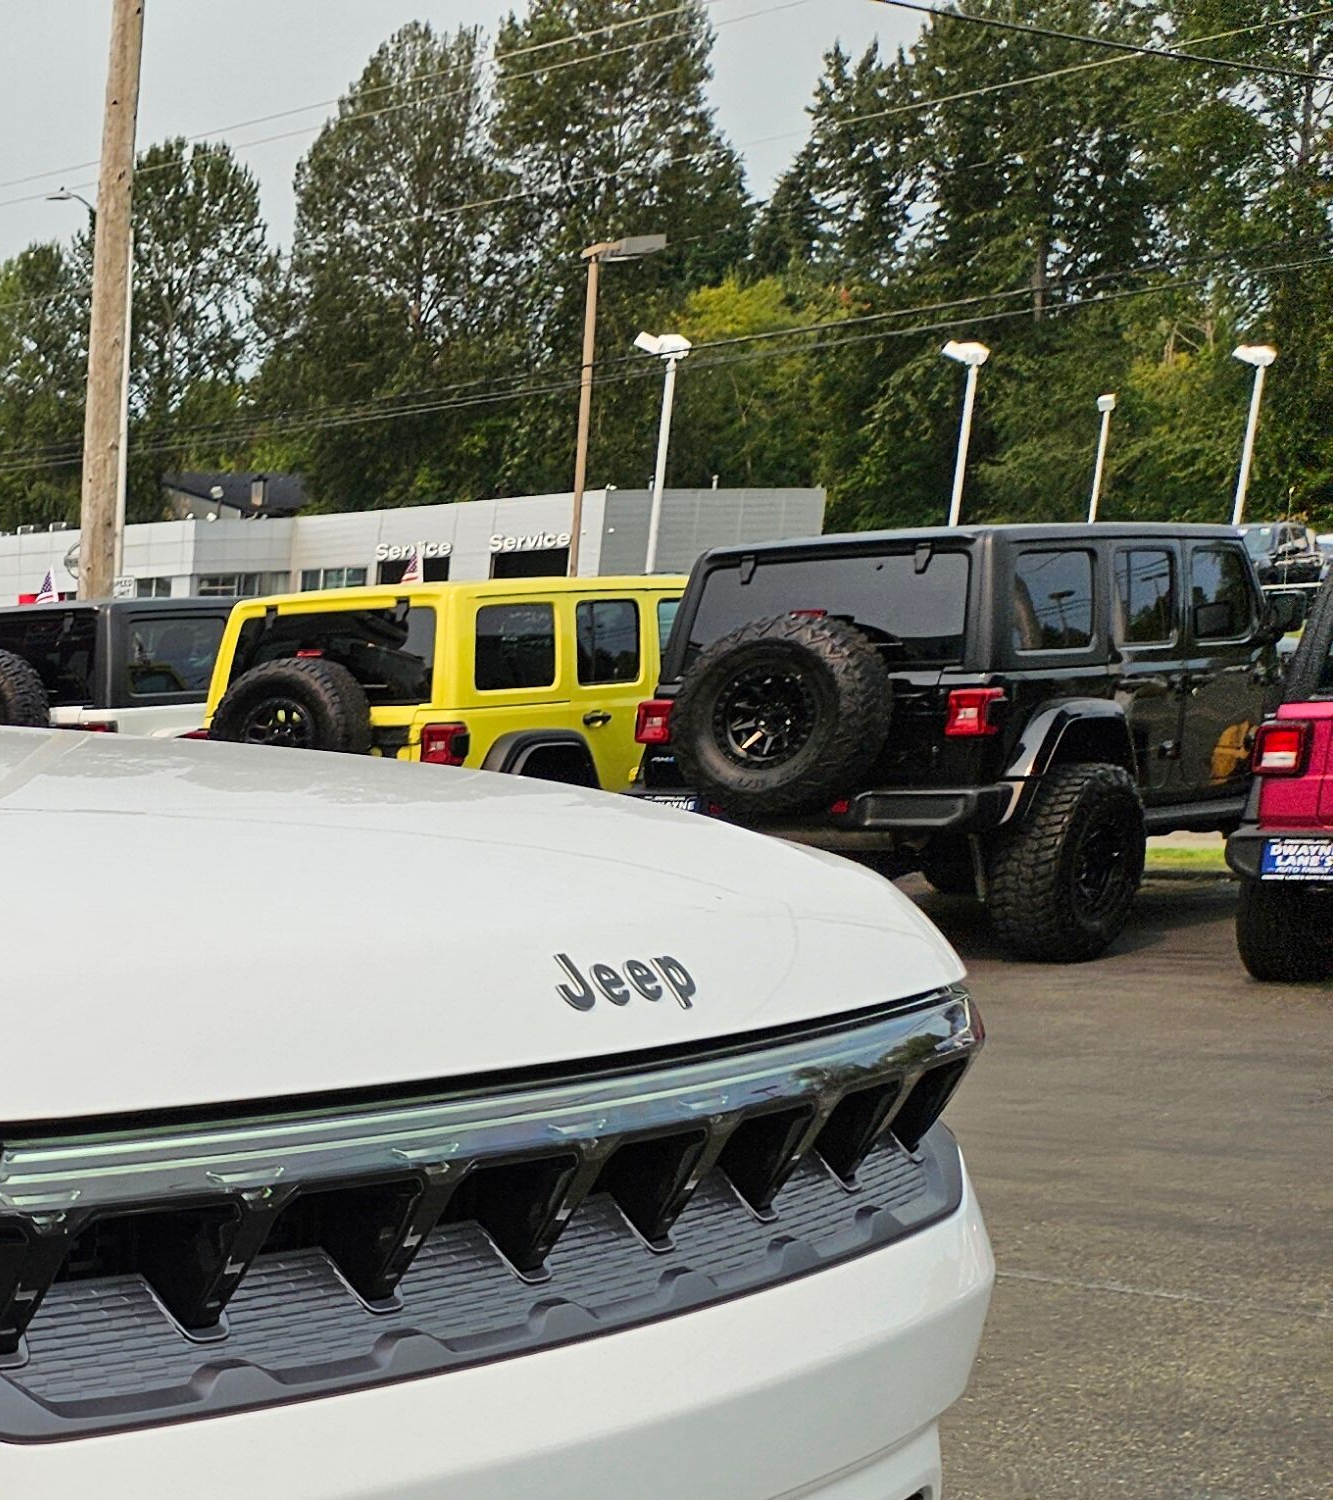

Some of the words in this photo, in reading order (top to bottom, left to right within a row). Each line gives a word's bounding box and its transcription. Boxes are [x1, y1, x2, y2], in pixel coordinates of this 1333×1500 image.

[488, 531, 571, 553] Service
[1270, 844, 1333, 856] DWAYN
[553, 953, 697, 1012] Jeep
